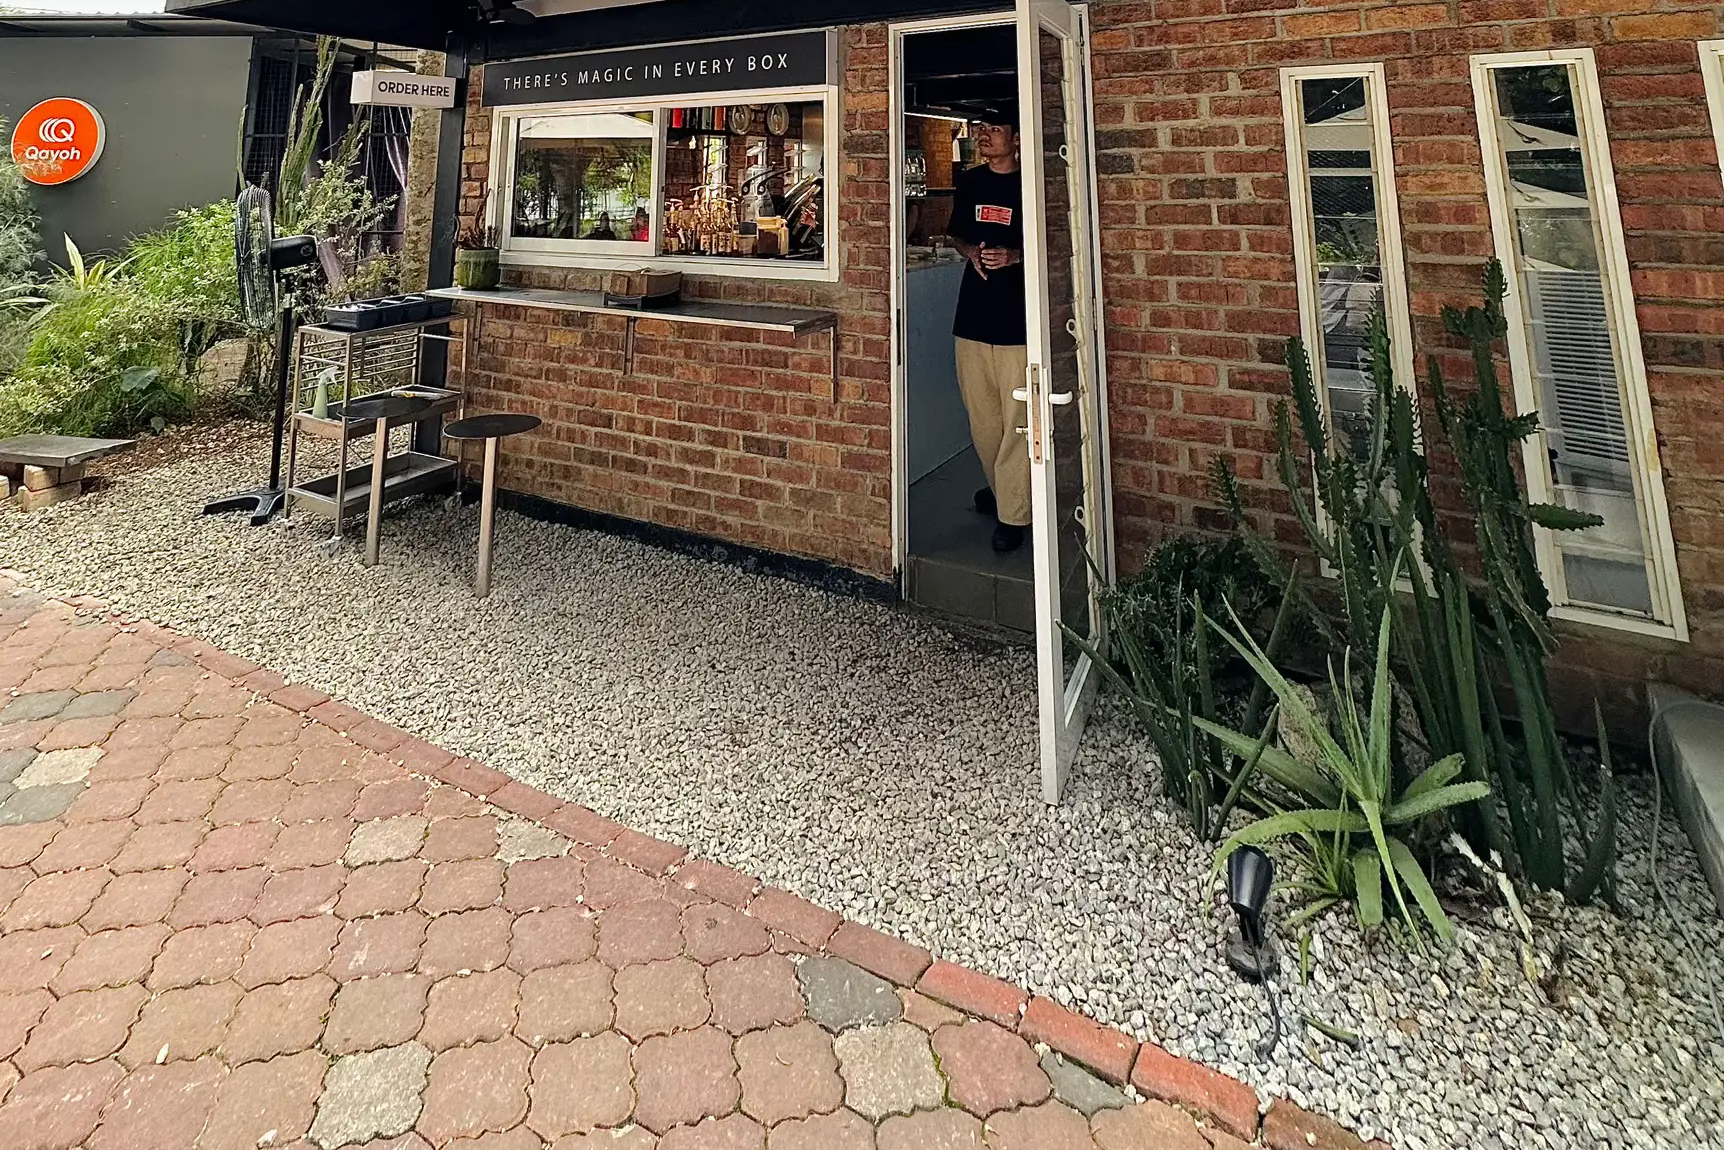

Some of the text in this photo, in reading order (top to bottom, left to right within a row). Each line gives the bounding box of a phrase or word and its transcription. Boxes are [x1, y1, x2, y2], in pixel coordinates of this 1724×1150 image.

[504, 53, 789, 91] THERE'S MAGIC IN EVERY BOX
[378, 81, 450, 98] ORDER HERE
[25, 145, 81, 163] Qayoh
